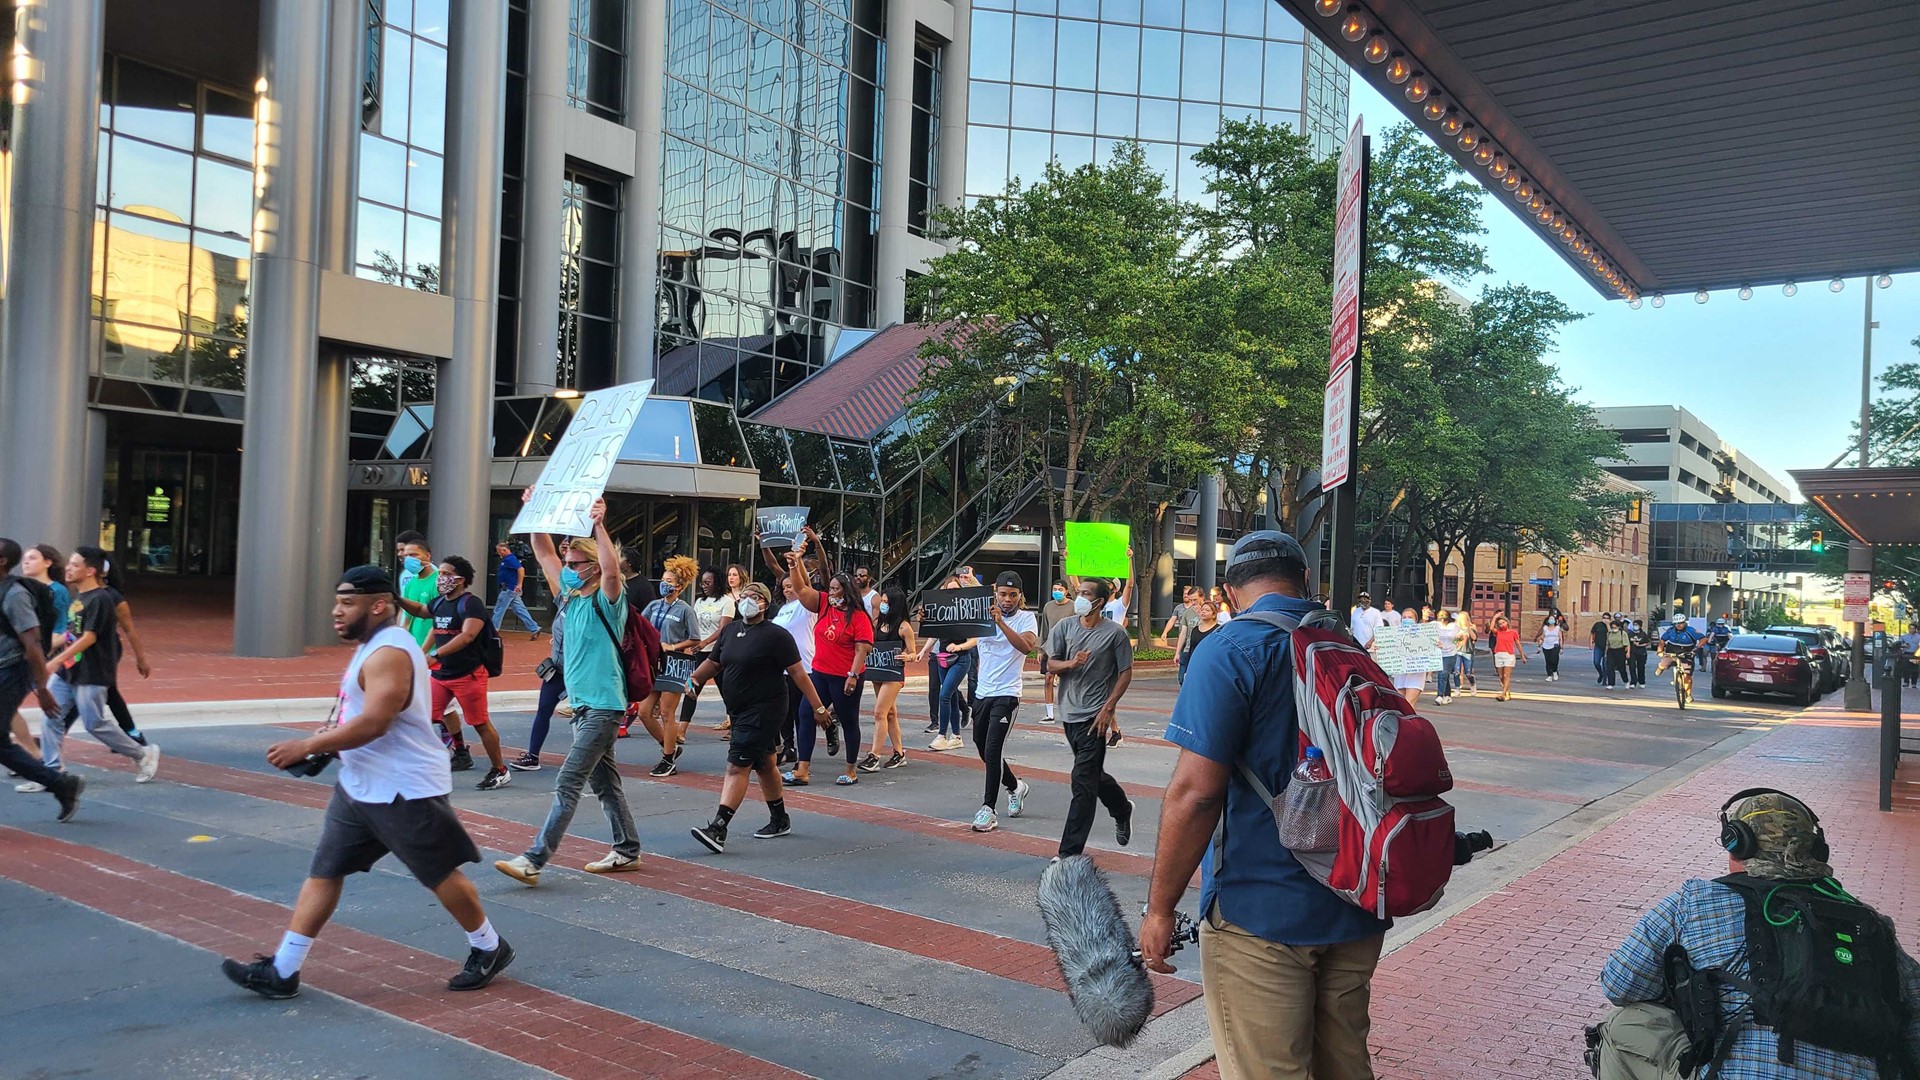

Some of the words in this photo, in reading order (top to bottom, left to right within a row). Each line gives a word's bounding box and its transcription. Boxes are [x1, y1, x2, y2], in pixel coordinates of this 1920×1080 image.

[570, 390, 647, 436] BLACK
[544, 434, 623, 486] LIVES
[518, 490, 593, 530] MATTER
[757, 515, 769, 535] I
[925, 603, 937, 622] I
[936, 597, 959, 622] can't
[960, 596, 994, 621] BREATHE
[1835, 950, 1852, 959] TVU
